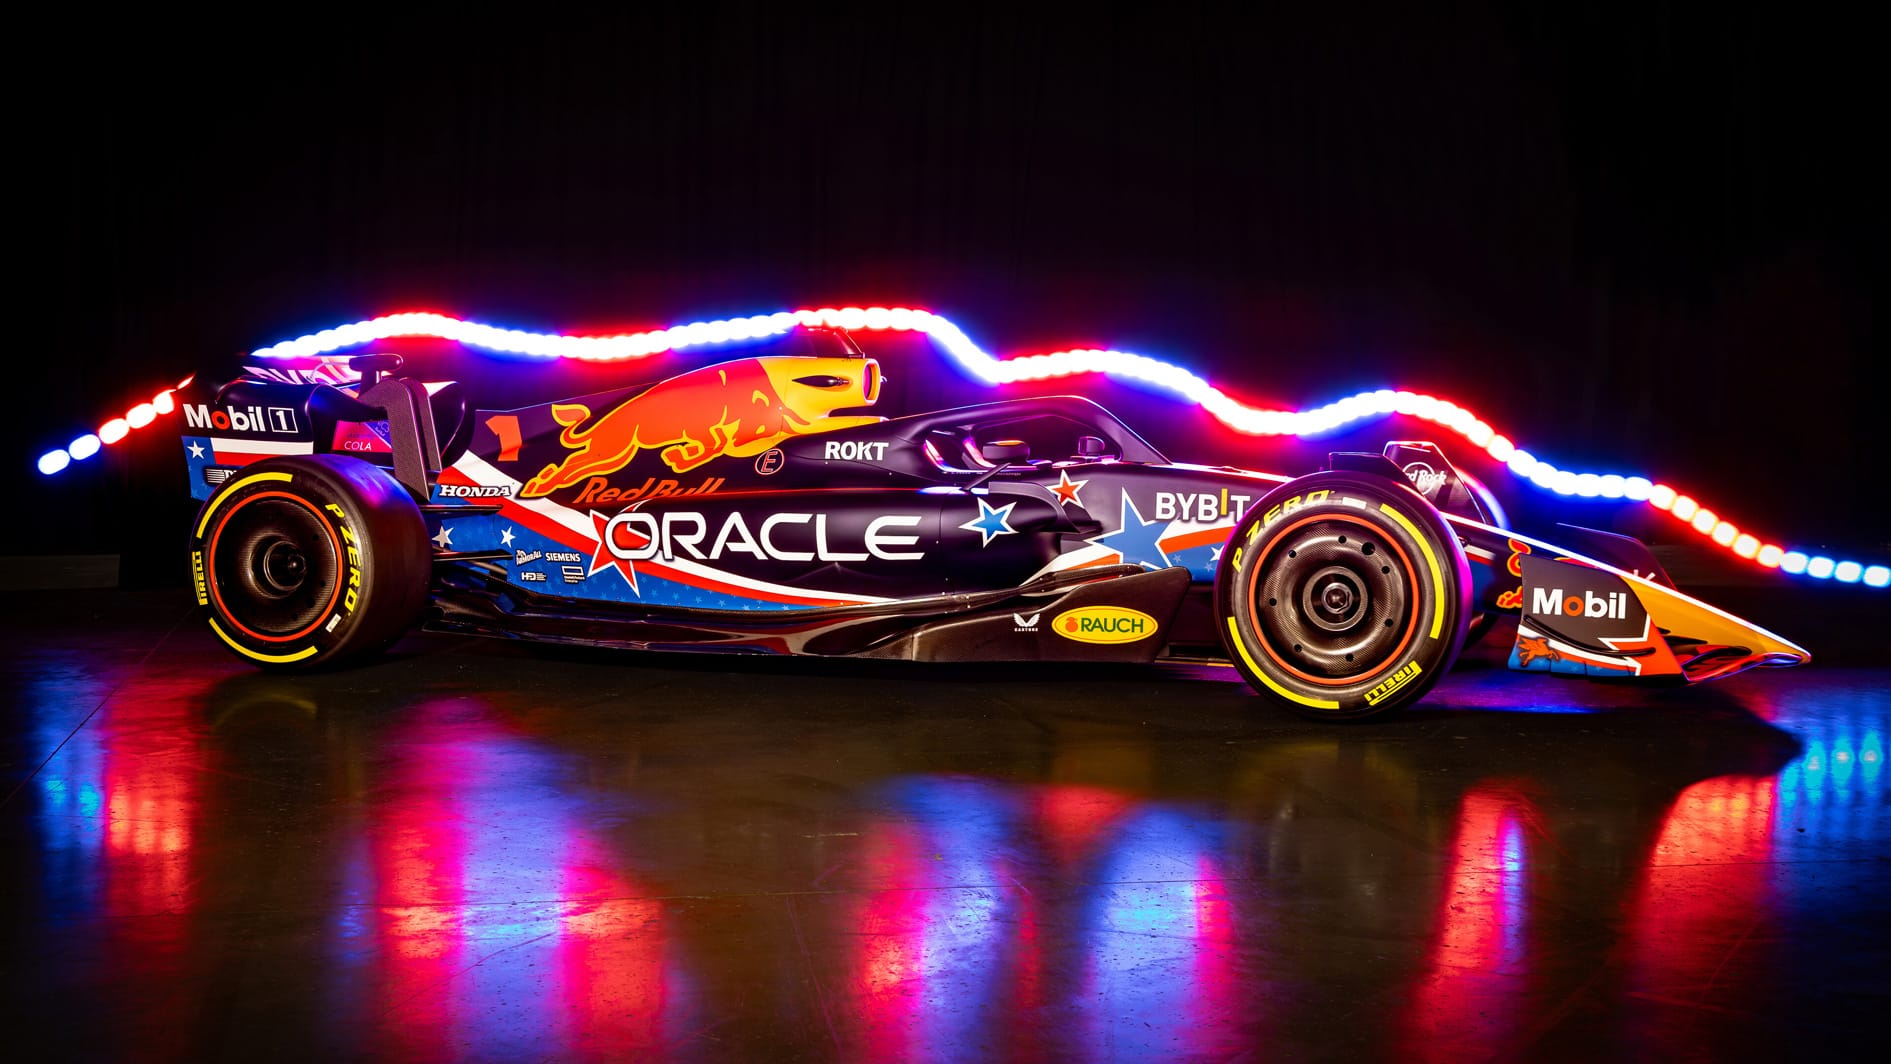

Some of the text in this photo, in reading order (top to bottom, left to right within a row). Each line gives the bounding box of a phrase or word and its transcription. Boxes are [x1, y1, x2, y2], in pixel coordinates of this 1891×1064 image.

[183, 403, 266, 432] Mobil
[344, 440, 372, 451] COLA
[485, 415, 522, 462] 1
[824, 441, 888, 461] ROKT
[439, 484, 512, 497] HONDA
[1155, 488, 1251, 523] BYBIT
[1246, 489, 1330, 545] ZERO
[604, 511, 926, 562] ORACLE
[339, 525, 362, 613] ZERO
[545, 552, 580, 562] SIEMENS
[192, 551, 209, 606] PIRELLI
[1532, 587, 1627, 619] Mobil
[1080, 617, 1144, 633] RAUCH
[1364, 660, 1422, 706] PIRELLI
